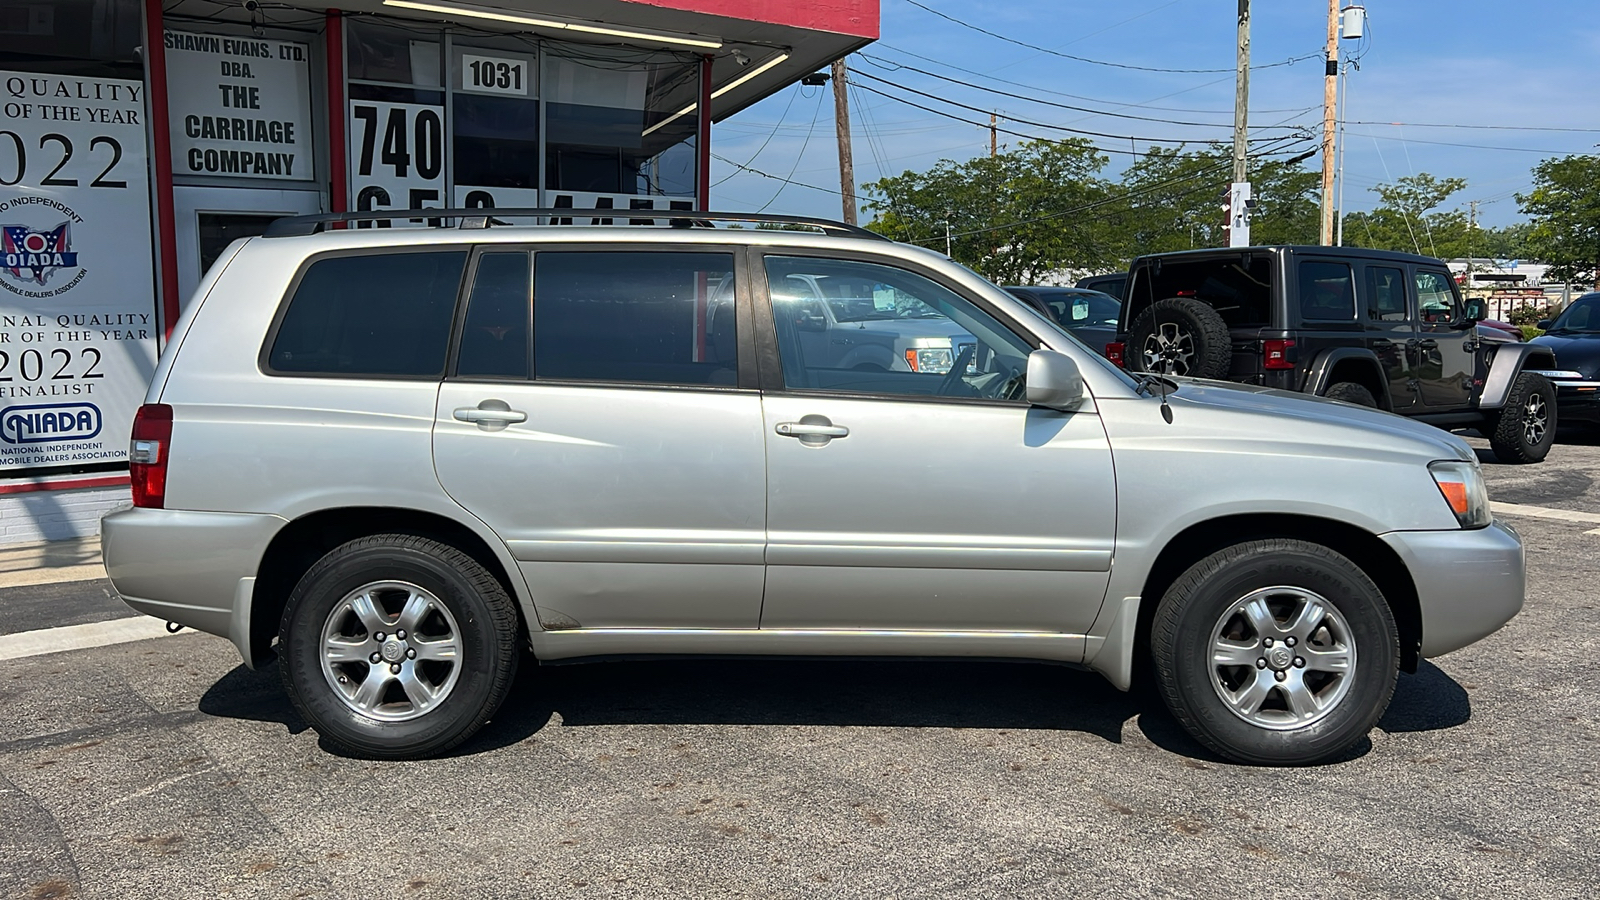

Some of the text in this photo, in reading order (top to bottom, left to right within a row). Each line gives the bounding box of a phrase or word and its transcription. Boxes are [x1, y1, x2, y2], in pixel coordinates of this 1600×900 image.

[163, 32, 307, 62] SHAWN EVANS. LTD.
[221, 61, 255, 78] DBA.
[469, 60, 521, 90] 1031
[6, 77, 140, 102] QUALITY
[218, 84, 260, 109] THE
[4, 102, 139, 124] OF THE YEAR
[185, 115, 295, 144] CARRIAGE
[354, 105, 441, 180] 740
[188, 148, 294, 175] COMPANY
[10, 196, 84, 224] INDEPENDENT
[6, 253, 64, 266] OIADA
[24, 290, 54, 298] DEALERS
[54, 268, 88, 296] ASSOCIATION
[57, 313, 149, 328] QUALITY
[21, 331, 45, 343] OF
[54, 330, 91, 342] THE
[101, 329, 148, 340] YEAR
[0, 347, 104, 382] 2022
[0, 383, 94, 398] FINALIST
[6, 410, 93, 437] NIADA
[1, 442, 103, 455] NATIONAL INDEPENDENT
[34, 454, 70, 463] DEALERS
[72, 450, 127, 461] ASSOCIATION
